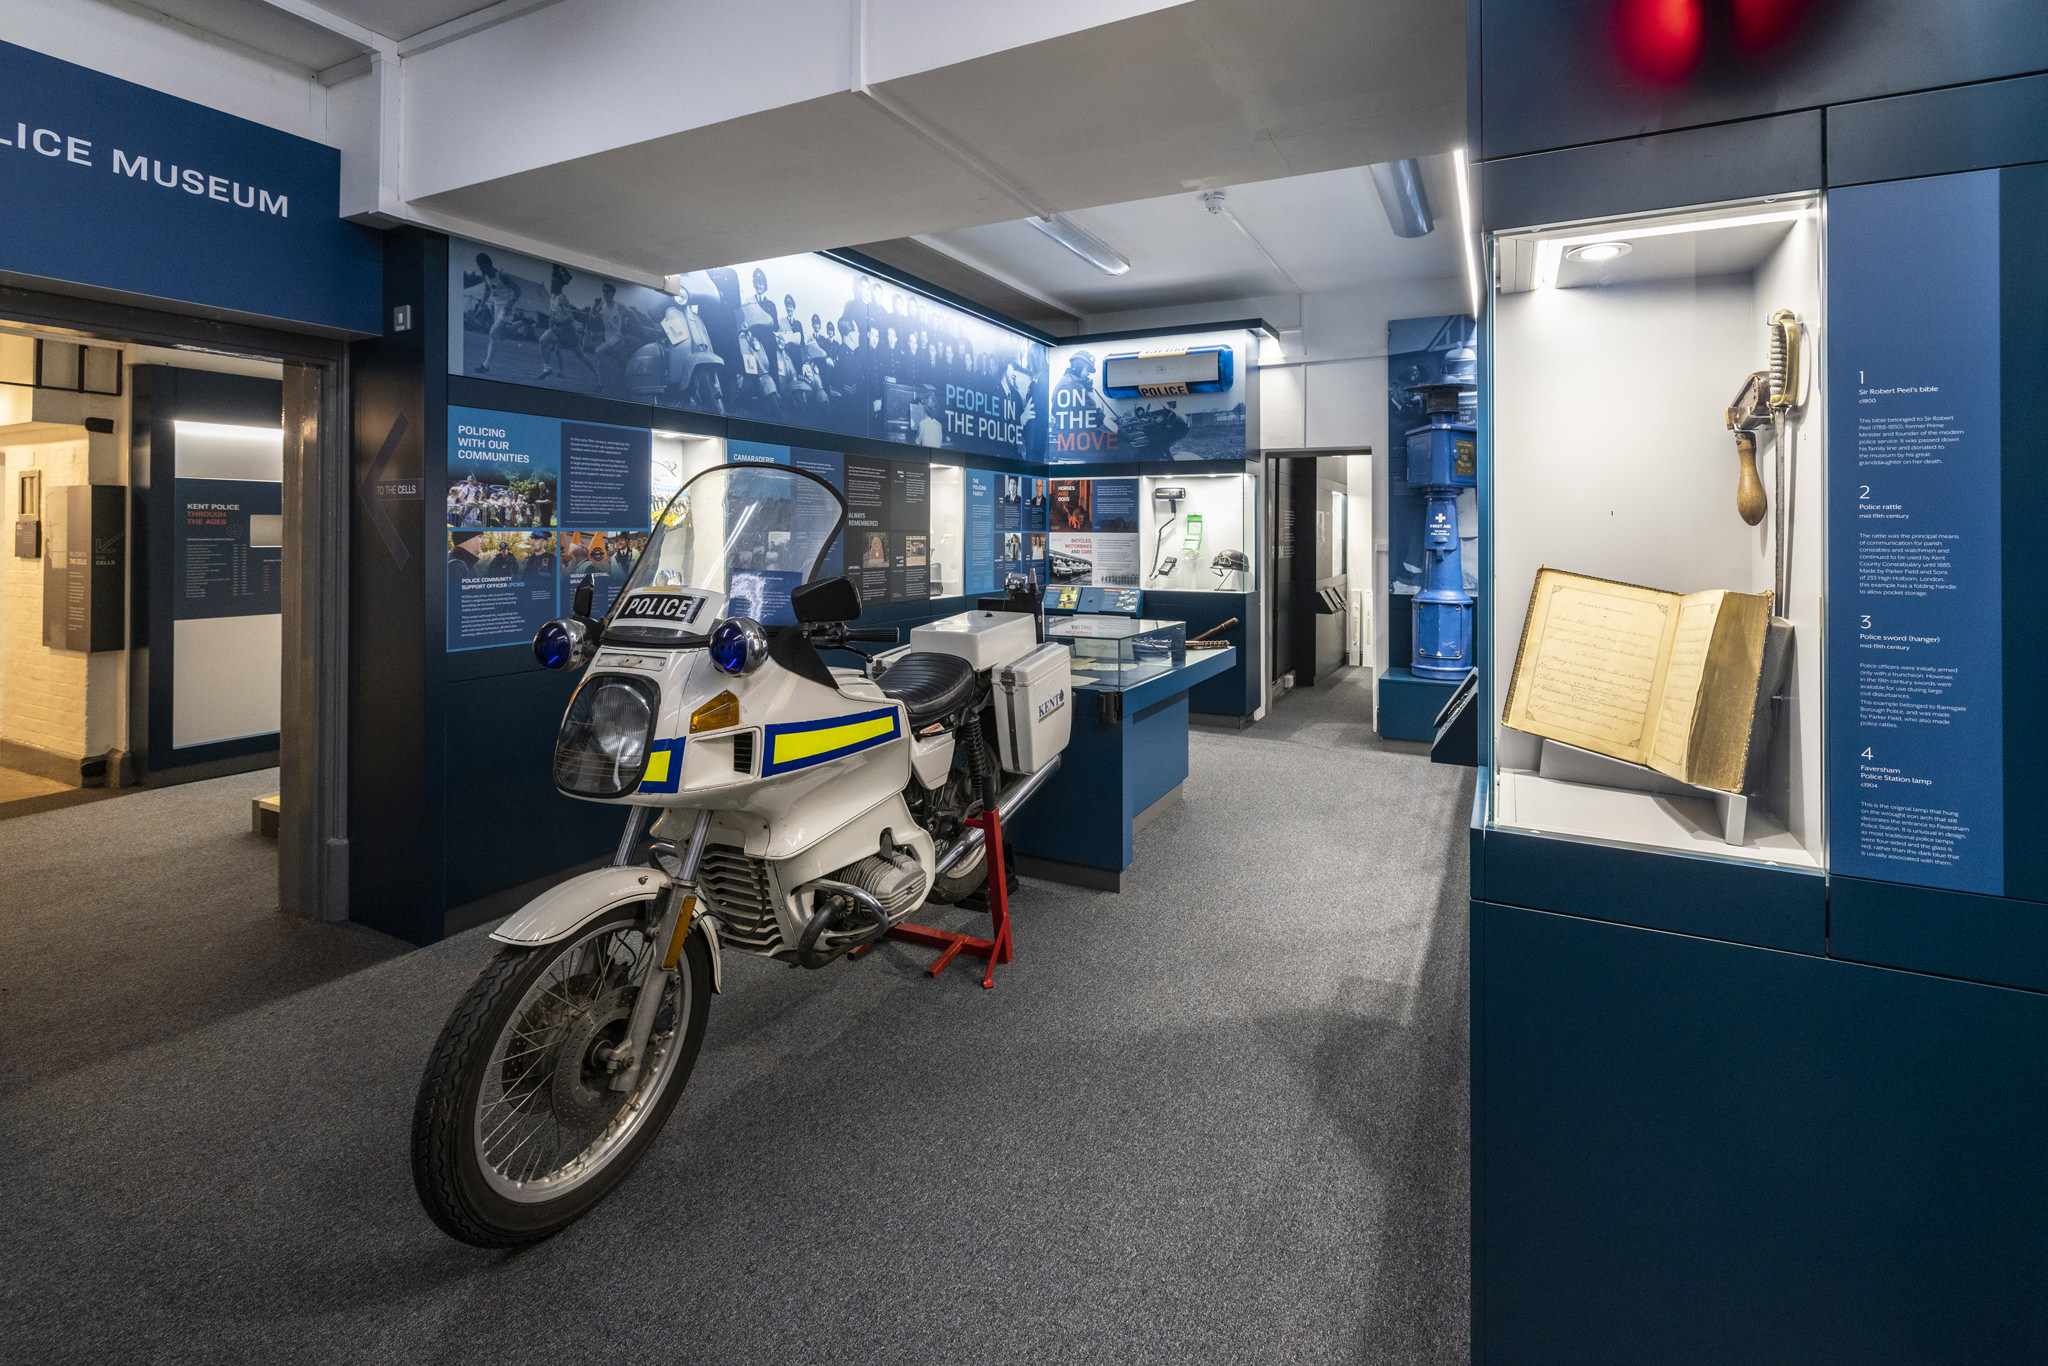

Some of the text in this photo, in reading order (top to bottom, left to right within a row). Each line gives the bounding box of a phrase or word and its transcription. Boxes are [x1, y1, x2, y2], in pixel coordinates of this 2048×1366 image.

[0, 122, 289, 218] ICE MUSEUM
[1859, 370, 1864, 384] 1
[1057, 388, 1086, 408] ON
[1141, 386, 1184, 397] POLICE
[946, 383, 1016, 420] PEOPLE IN
[1056, 410, 1098, 429] THE
[458, 425, 506, 438] POLICING
[946, 410, 1023, 445] THE POLICE
[458, 438, 509, 450] WITH OUR
[1057, 432, 1119, 451] MOVE
[458, 450, 530, 464] COMMUNITIES
[734, 454, 775, 463] CAMARADERIE
[377, 485, 416, 494] TO THE CELLS
[1859, 485, 1870, 499] 2
[624, 598, 692, 617] POLICE
[1860, 615, 1871, 629] 3
[1908, 636, 1940, 644] (hanger)
[1038, 694, 1059, 717] KENT
[1861, 747, 1874, 760] 4
[1861, 765, 1900, 773] Faversham
[1911, 777, 1932, 785] lamp
[1890, 805, 1912, 813] original
[1936, 823, 1969, 831] Faversham
